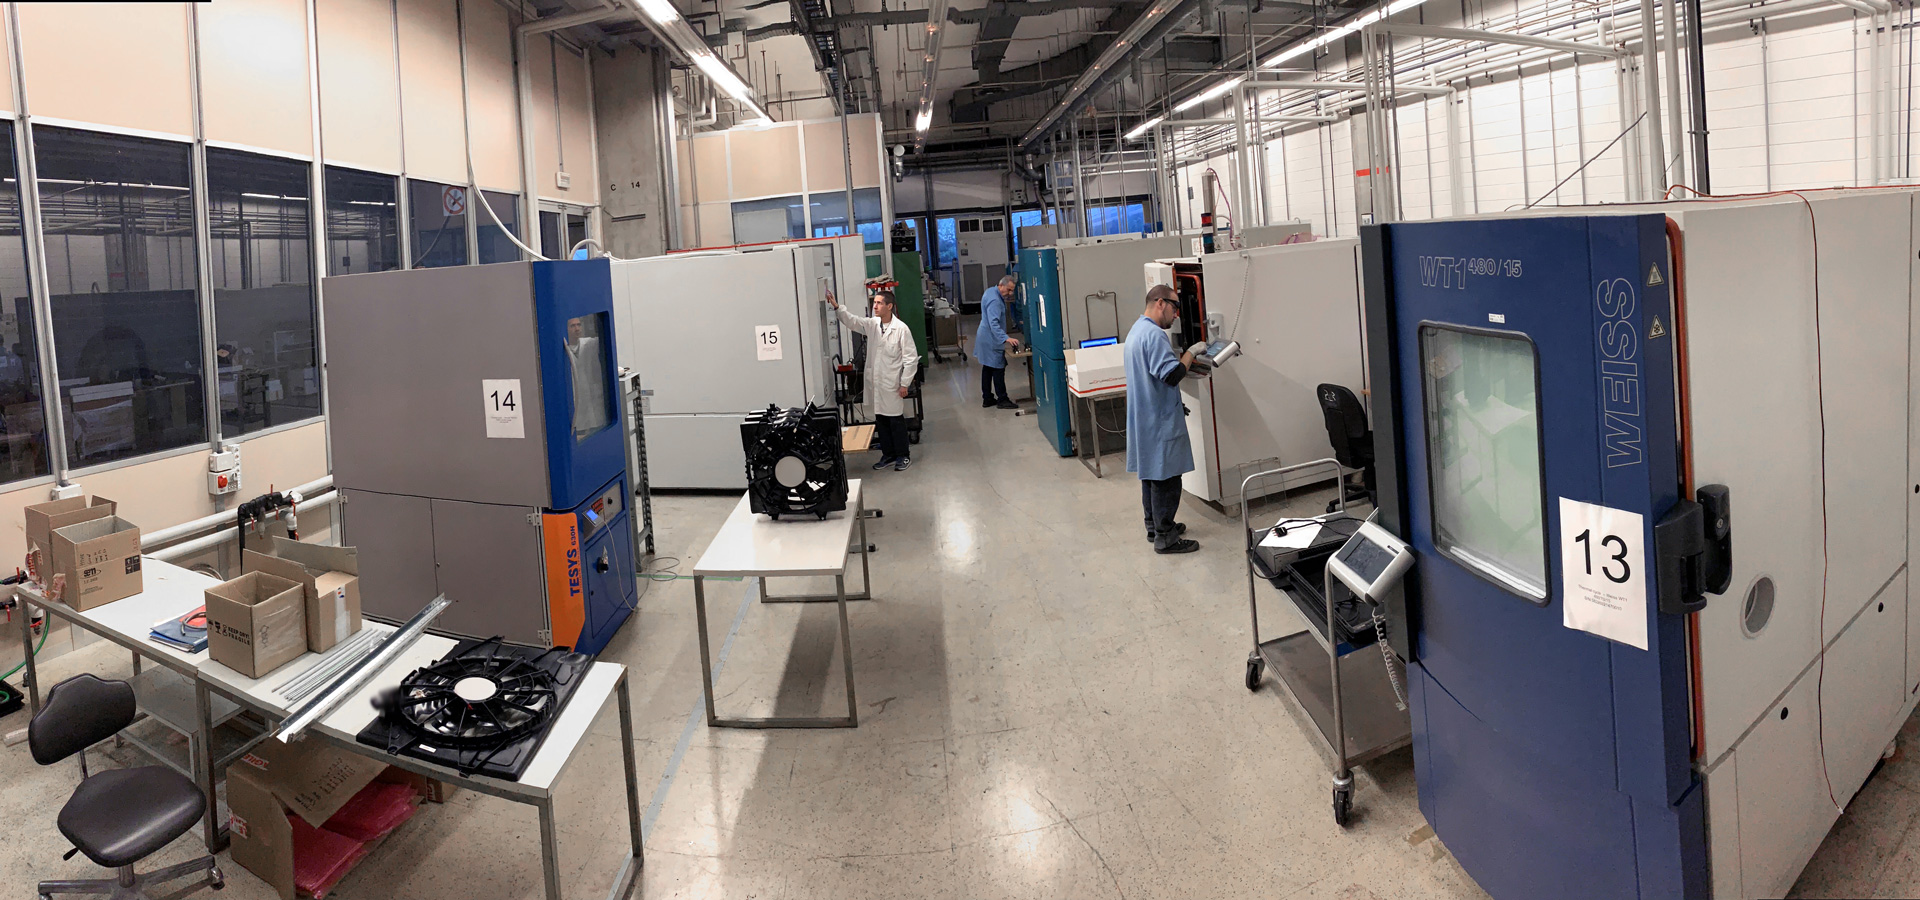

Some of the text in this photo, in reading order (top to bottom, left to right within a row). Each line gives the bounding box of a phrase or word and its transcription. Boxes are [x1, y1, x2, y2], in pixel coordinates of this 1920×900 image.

[1419, 256, 1467, 289] WT1
[761, 331, 777, 344] 15
[1597, 278, 1641, 468] WEISS
[490, 390, 516, 411] 14
[567, 548, 580, 597] TESYS
[1575, 529, 1631, 583] 13
[228, 633, 250, 645] FRAGILE
